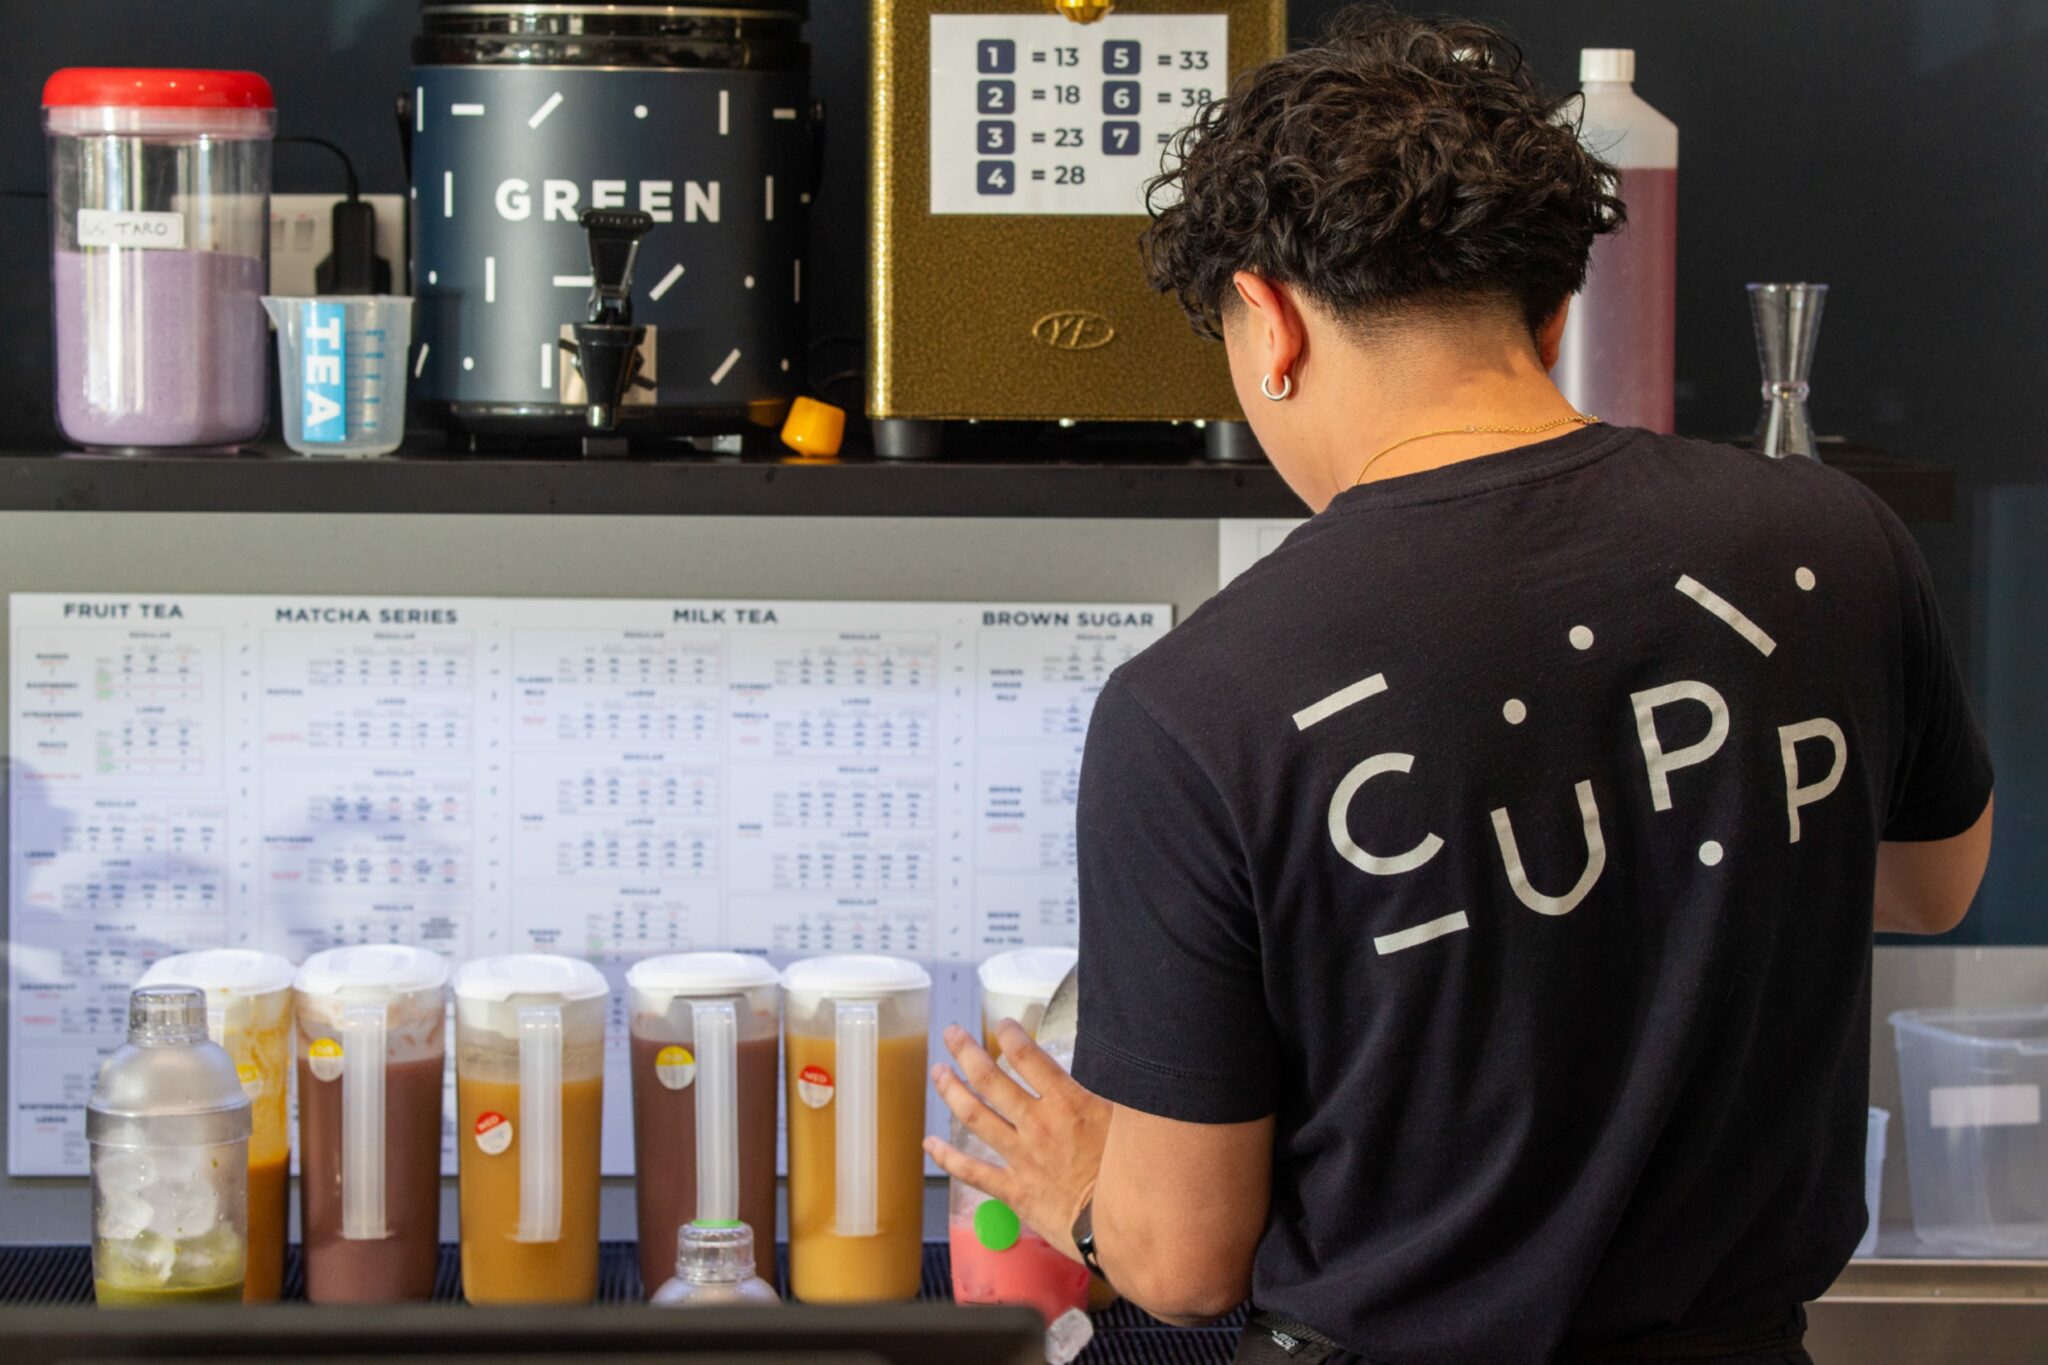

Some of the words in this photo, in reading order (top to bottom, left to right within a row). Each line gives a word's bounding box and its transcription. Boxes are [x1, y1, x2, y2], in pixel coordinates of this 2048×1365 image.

[988, 47, 997, 67] 1
[1055, 48, 1079, 66] 13
[1114, 48, 1129, 68] 5
[1180, 51, 1208, 70] 33
[988, 87, 1003, 107] 2
[1055, 85, 1080, 104] 18
[1114, 88, 1130, 108] 6
[988, 128, 1003, 147] 3
[1055, 128, 1083, 147] 23
[1113, 129, 1129, 148] 7
[988, 168, 1006, 188] 4
[1055, 166, 1085, 184] 28
[495, 178, 720, 222] GREEN
[114, 222, 168, 236] TARO
[306, 317, 341, 428] TEA
[64, 603, 129, 618] FRUIT
[141, 604, 182, 618] TEA
[276, 609, 370, 622] MATCHA
[380, 609, 457, 624] SERIES
[674, 610, 725, 623] MILK
[736, 610, 777, 623] TEA
[983, 612, 1068, 626] BROWN
[1078, 613, 1153, 626] SUGAR
